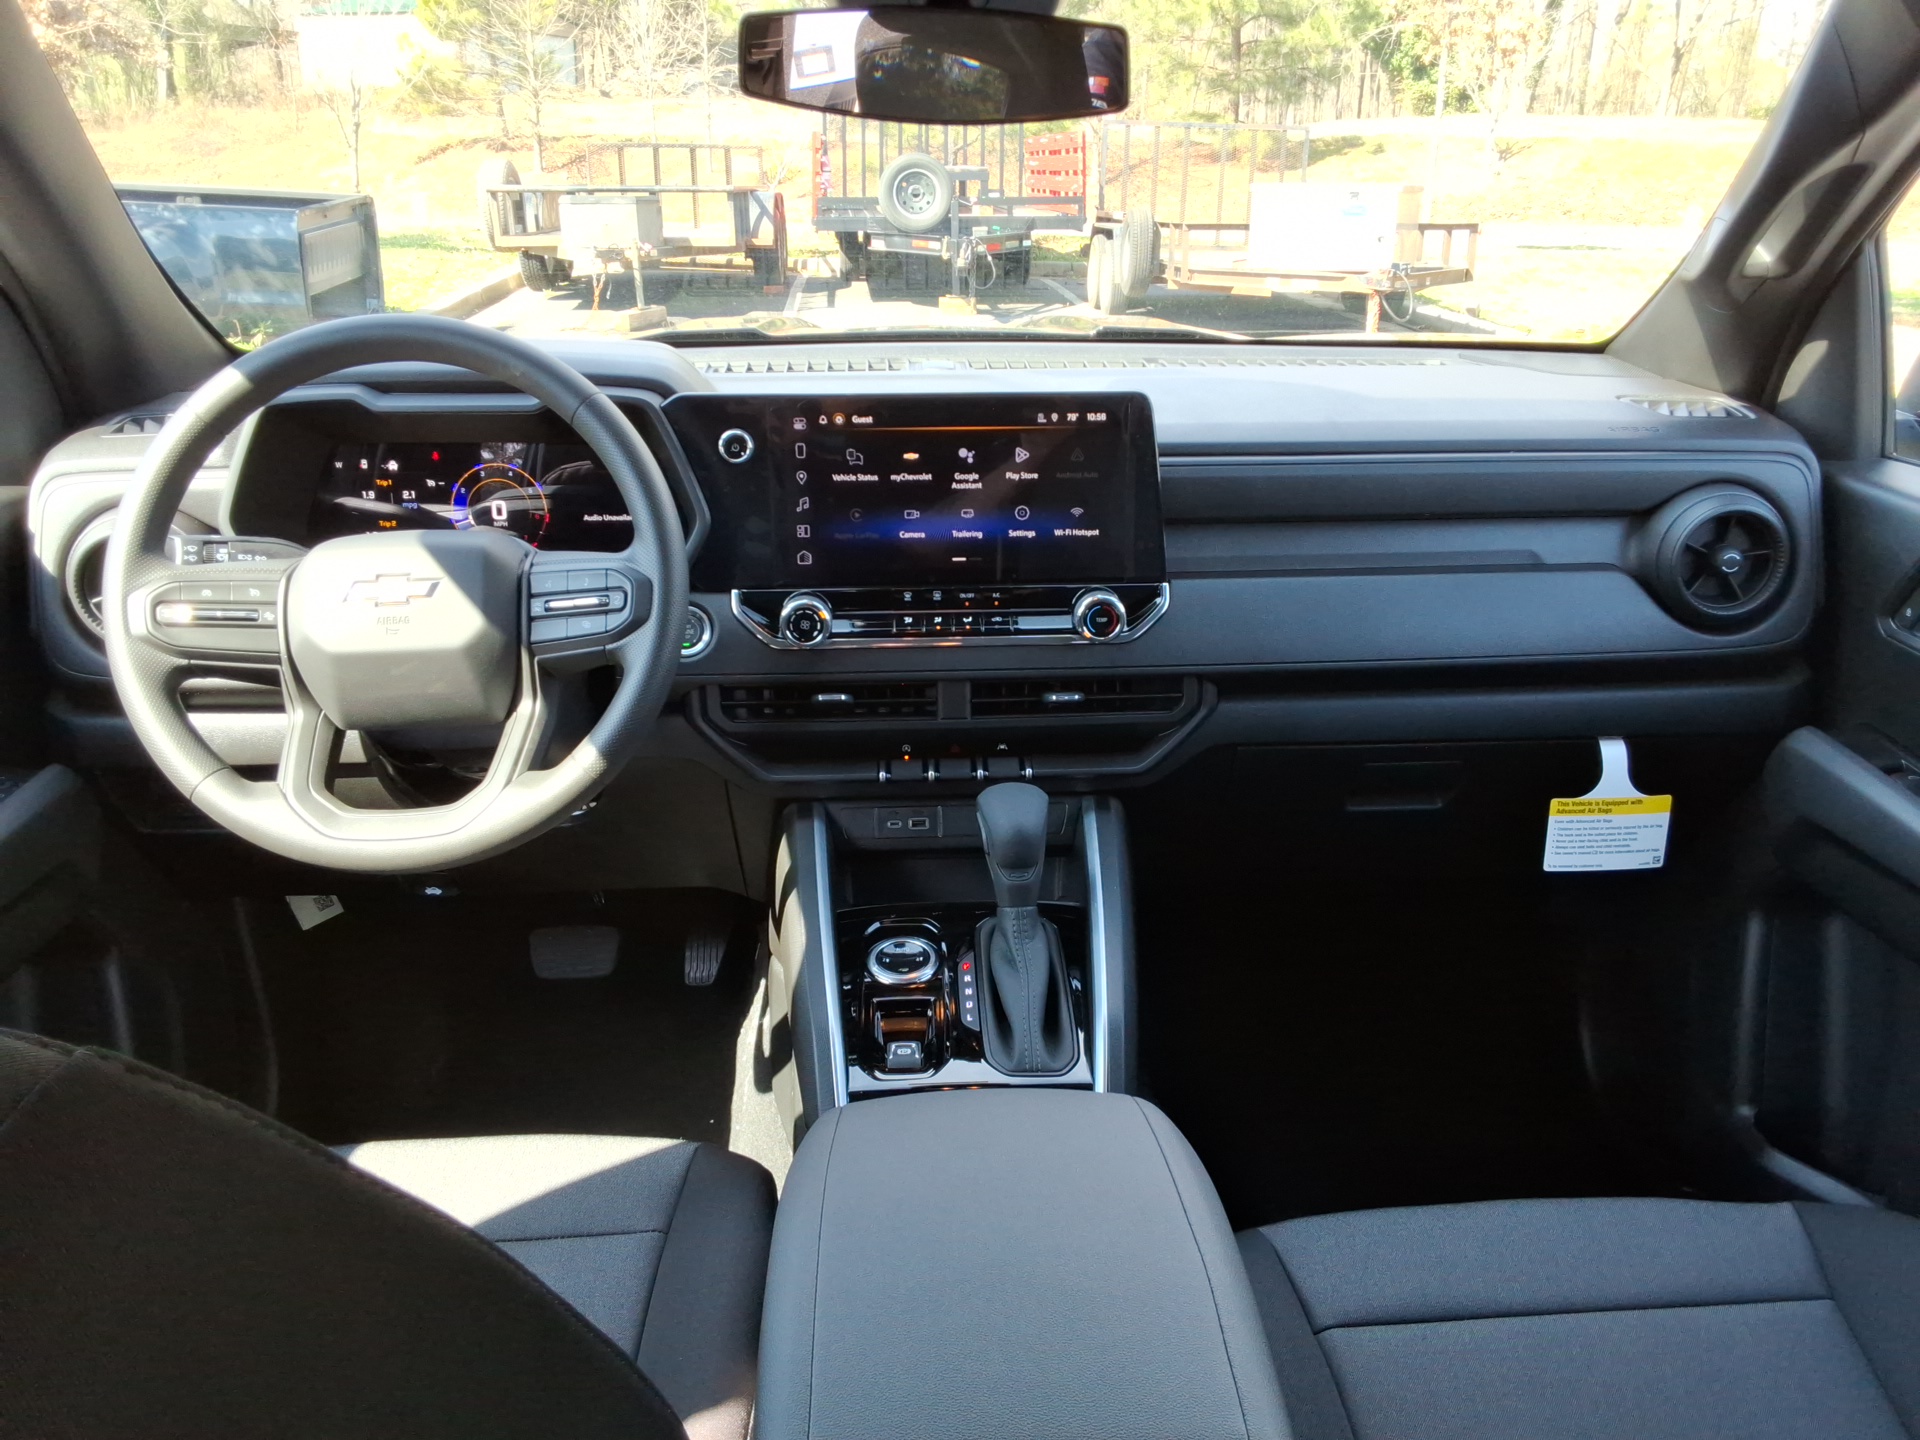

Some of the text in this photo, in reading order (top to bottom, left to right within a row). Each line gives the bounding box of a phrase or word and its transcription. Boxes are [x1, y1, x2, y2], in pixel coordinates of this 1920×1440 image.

[851, 414, 874, 424] Guest
[334, 461, 343, 469] W
[832, 473, 879, 482] Vehicle Status
[890, 472, 933, 482] myChevrolet
[954, 472, 980, 482] Google
[1005, 471, 1039, 481] Play Store
[376, 479, 389, 487] Trip
[951, 481, 983, 490] Assistant
[361, 490, 376, 499] 1.9
[402, 490, 416, 499] 2.1
[491, 500, 508, 520] 0
[583, 513, 633, 521] Audio Unavaila
[379, 520, 392, 528] Trip
[899, 530, 926, 539] Camera
[952, 530, 983, 540] Trailering
[1008, 529, 1036, 538] Settings
[1054, 528, 1100, 538] Wi-Fi Hotspot
[377, 615, 410, 625] AIRBAG
[1601, 799, 1629, 807] Equipped
[1597, 807, 1612, 815] Bags
